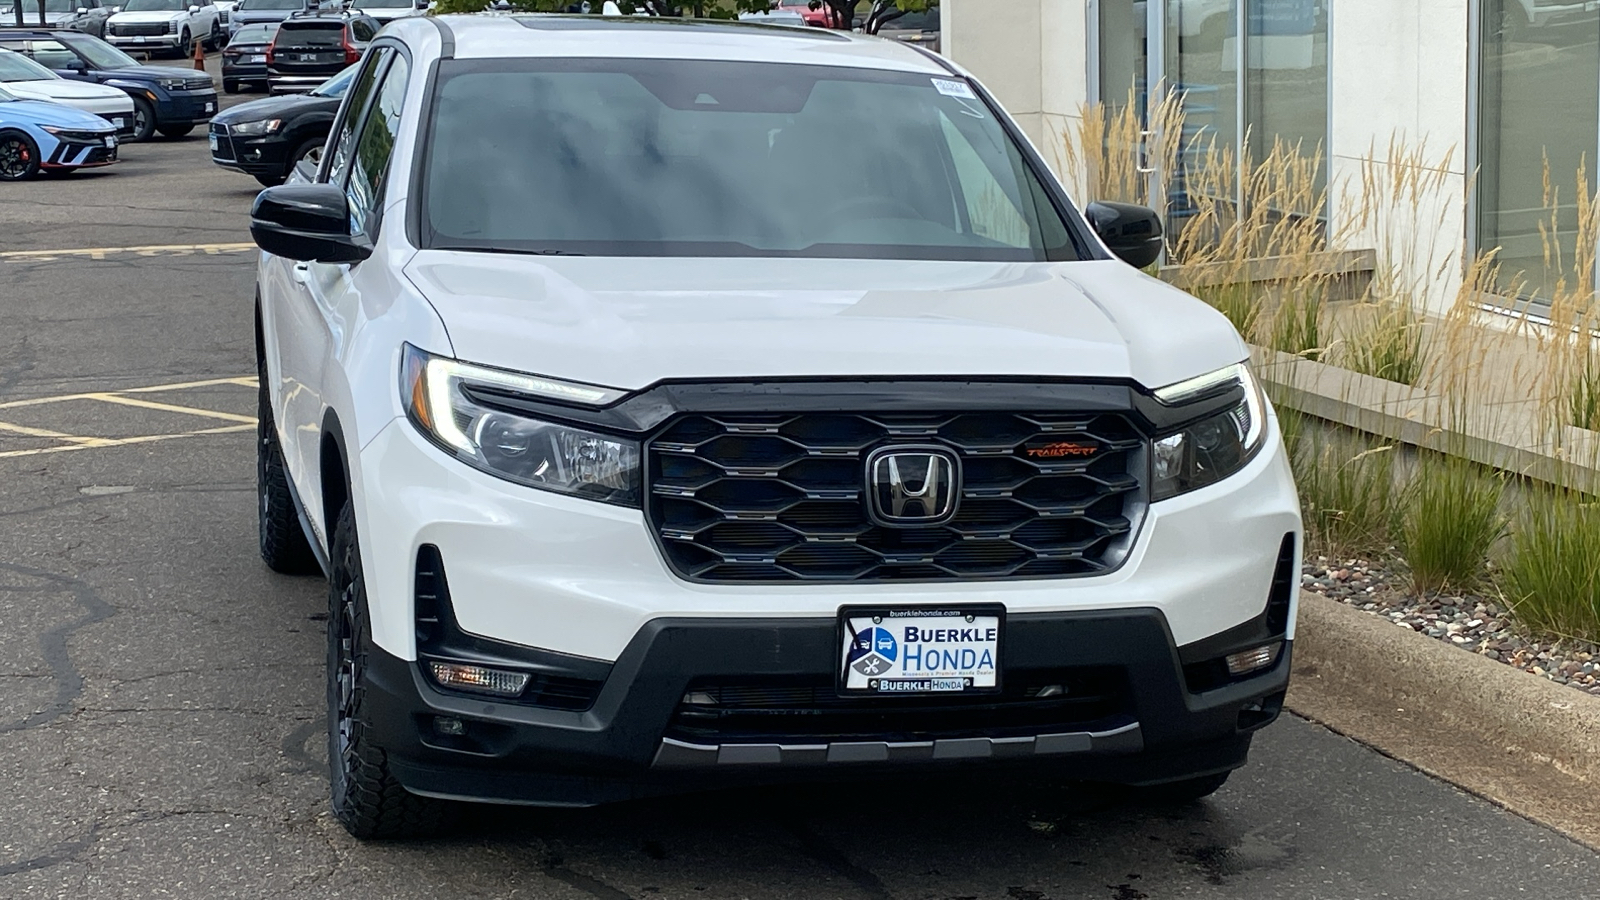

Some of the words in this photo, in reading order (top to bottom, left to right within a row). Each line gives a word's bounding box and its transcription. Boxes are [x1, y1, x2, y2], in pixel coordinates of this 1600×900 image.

[1026, 447, 1098, 457] TRAILSPORT
[904, 626, 996, 643] BUERKLE
[902, 644, 994, 671] HONDA
[880, 680, 931, 691] BUERKLE
[932, 680, 962, 690] HONDA
